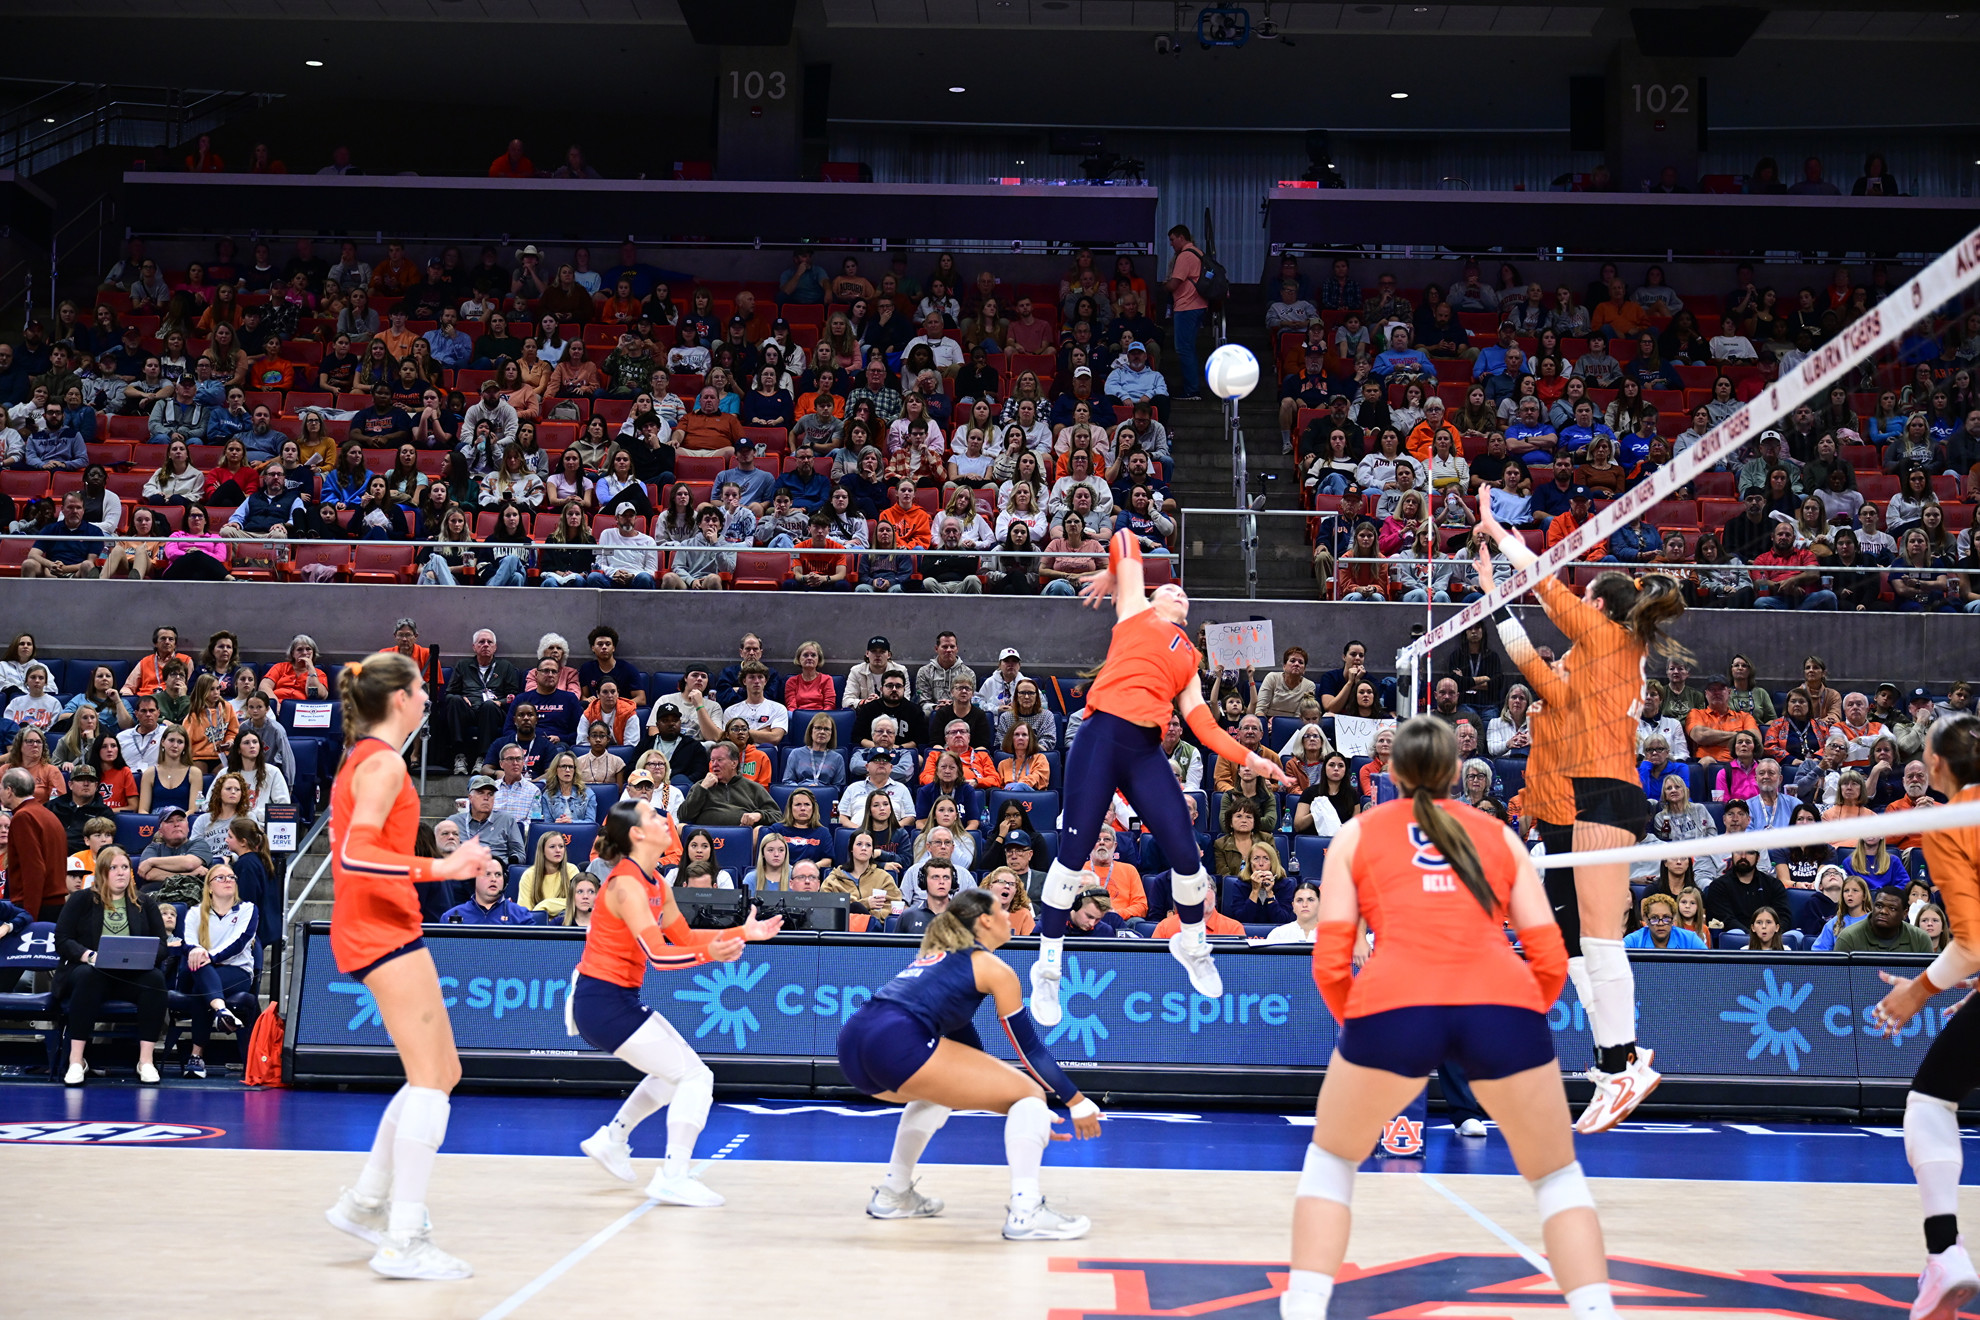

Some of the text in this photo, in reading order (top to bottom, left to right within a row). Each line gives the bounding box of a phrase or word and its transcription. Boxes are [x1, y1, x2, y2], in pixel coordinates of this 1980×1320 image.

[729, 71, 786, 99] 103
[1632, 84, 1689, 113] 102
[1843, 310, 1881, 359] TIGERS
[1930, 426, 1953, 435] PAC
[1338, 719, 1371, 736] We
[138, 824, 154, 837] AU
[1407, 822, 1452, 871] 5
[1422, 874, 1457, 891] BELL
[466, 976, 571, 1019] spir
[776, 984, 805, 1016] c
[1124, 991, 1290, 1034] c spire
[1823, 1004, 1854, 1037] c
[1381, 1115, 1424, 1155] AU
